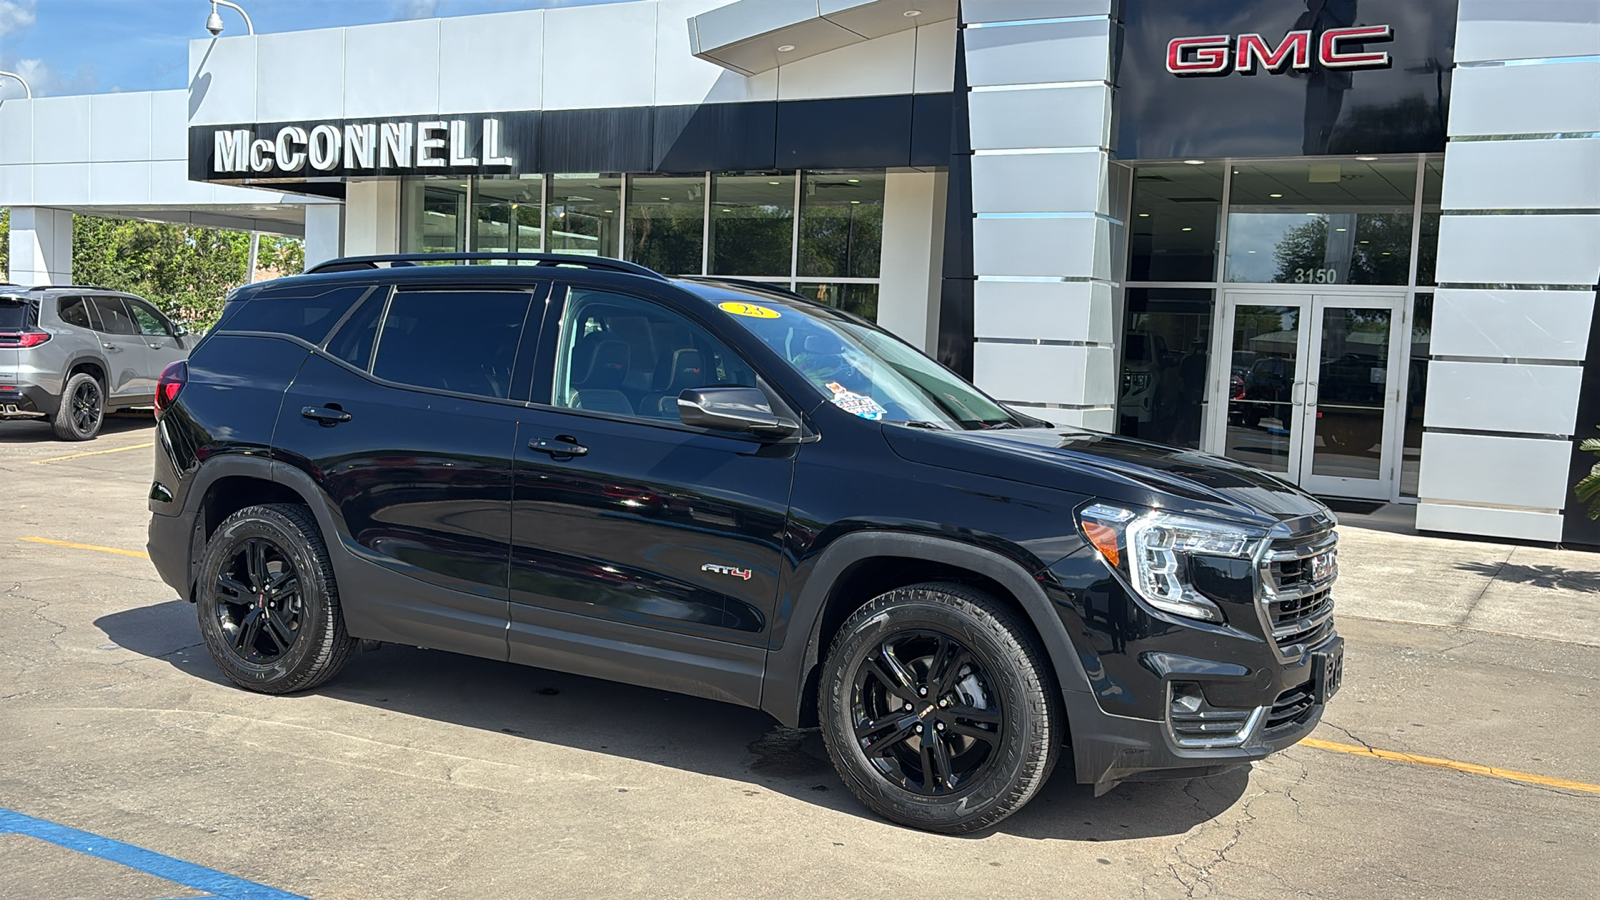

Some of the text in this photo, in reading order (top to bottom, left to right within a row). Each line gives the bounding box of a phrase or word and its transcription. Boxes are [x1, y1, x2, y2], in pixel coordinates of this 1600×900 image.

[1166, 24, 1391, 74] GMC
[213, 118, 513, 173] McCONNELL
[1294, 268, 1337, 284] 3150
[737, 303, 764, 316] 23
[701, 563, 752, 581] AT4
